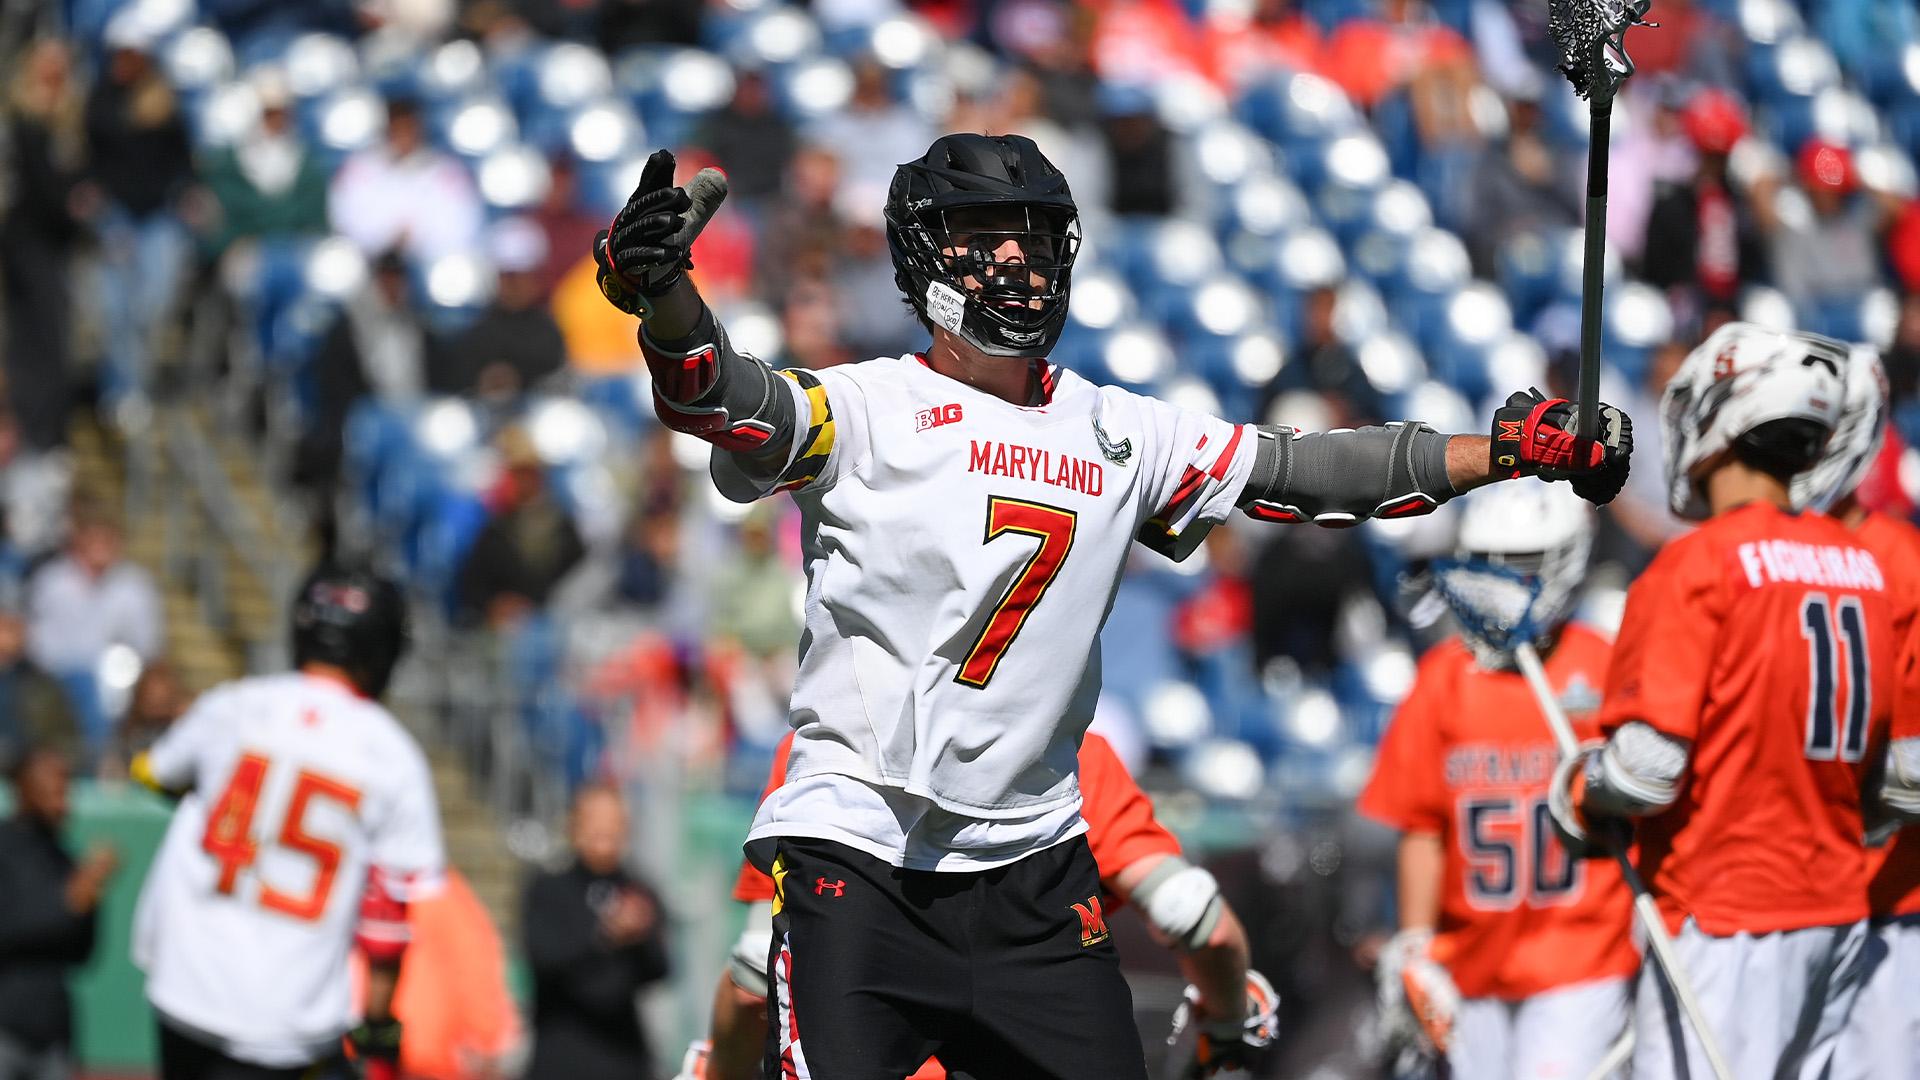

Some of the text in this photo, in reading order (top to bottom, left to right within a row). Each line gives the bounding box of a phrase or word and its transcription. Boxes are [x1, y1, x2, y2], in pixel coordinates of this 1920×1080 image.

[968, 440, 1103, 497] MARYLAND
[953, 494, 1078, 690] 7
[1737, 539, 1885, 592] FIGUEIRAS
[1799, 591, 1872, 763] 11
[202, 753, 362, 922] 45
[1456, 793, 1588, 912] 50
